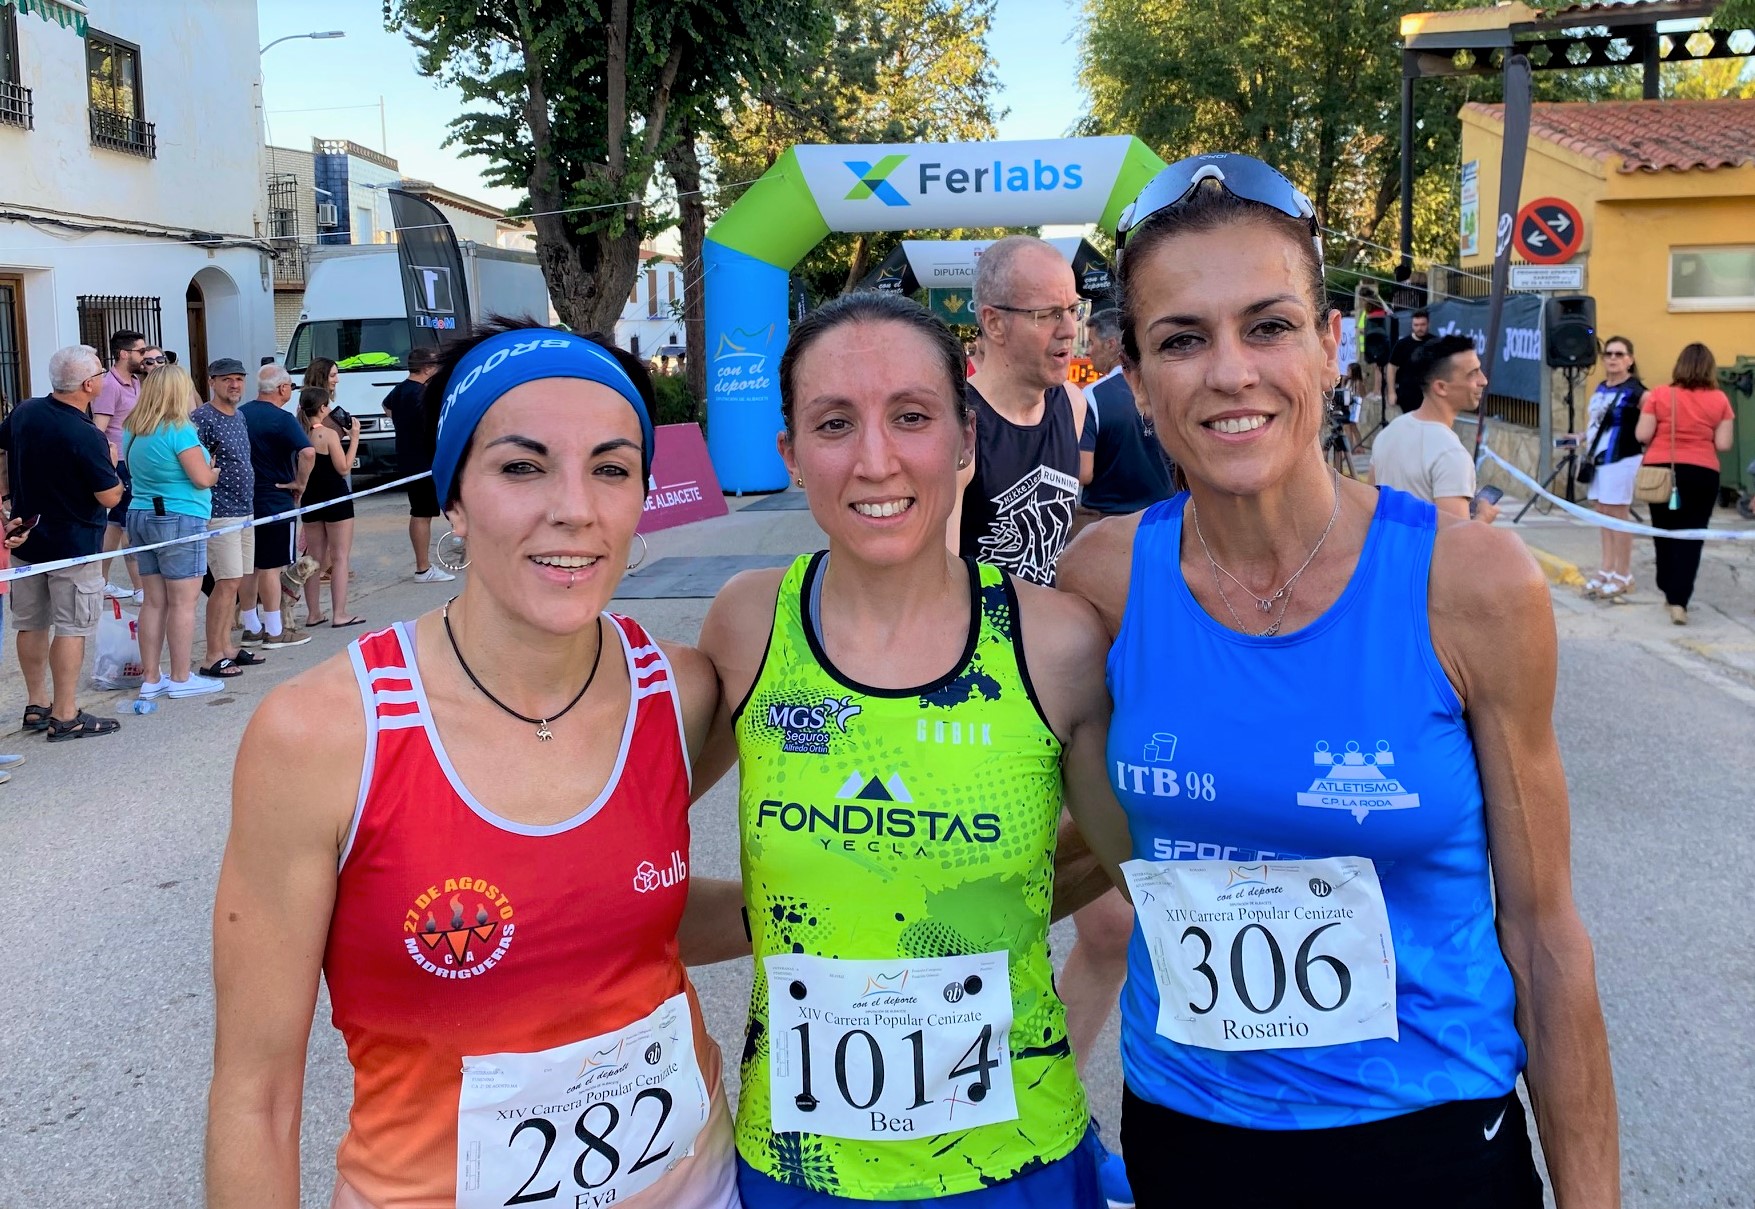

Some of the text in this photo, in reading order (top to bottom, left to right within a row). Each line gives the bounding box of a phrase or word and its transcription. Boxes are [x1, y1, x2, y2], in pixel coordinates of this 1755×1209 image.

[919, 159, 1083, 194] Ferlabs
[934, 268, 973, 276] DIPUTACI
[717, 358, 766, 377] con el
[714, 376, 770, 396] deporte
[656, 487, 703, 509] ALBACETE
[1003, 470, 1078, 505] Mikkeller RUNNING
[767, 706, 826, 729] MGS
[785, 731, 829, 743] Seguros
[916, 719, 992, 746] GOBIK
[784, 744, 808, 752] Alfredo
[1116, 760, 1216, 802] ITB 98
[1316, 782, 1399, 793] ATLETISMO
[1342, 799, 1358, 807] LA
[1359, 799, 1393, 807] RODA
[756, 800, 1001, 843] FONDISTAS
[820, 838, 927, 857] YECLA
[1216, 885, 1284, 902] con el deporte
[403, 876, 514, 934] 27 DE AGOSTO
[1166, 906, 1354, 923] XIV Carrera Popular Cenizate
[404, 923, 515, 979] MADRIGUERAS
[444, 950, 475, 965] C A
[1180, 922, 1352, 1015] 306
[852, 996, 918, 1009] con el deporte
[798, 1006, 982, 1029] XIV Carrera Popular Cenizate
[1223, 1016, 1310, 1040] Rosario
[791, 1022, 999, 1110] 1014
[566, 1082, 581, 1094] con
[585, 1074, 594, 1086] el
[597, 1062, 630, 1080] deporte
[496, 1107, 528, 1121] XIV
[531, 1099, 582, 1116] Carrera
[586, 1081, 633, 1104] Popular
[635, 1062, 679, 1087] Cenizate
[869, 1111, 915, 1133] Bea
[503, 1087, 675, 1207] 282
[573, 1188, 617, 1209] Eva
